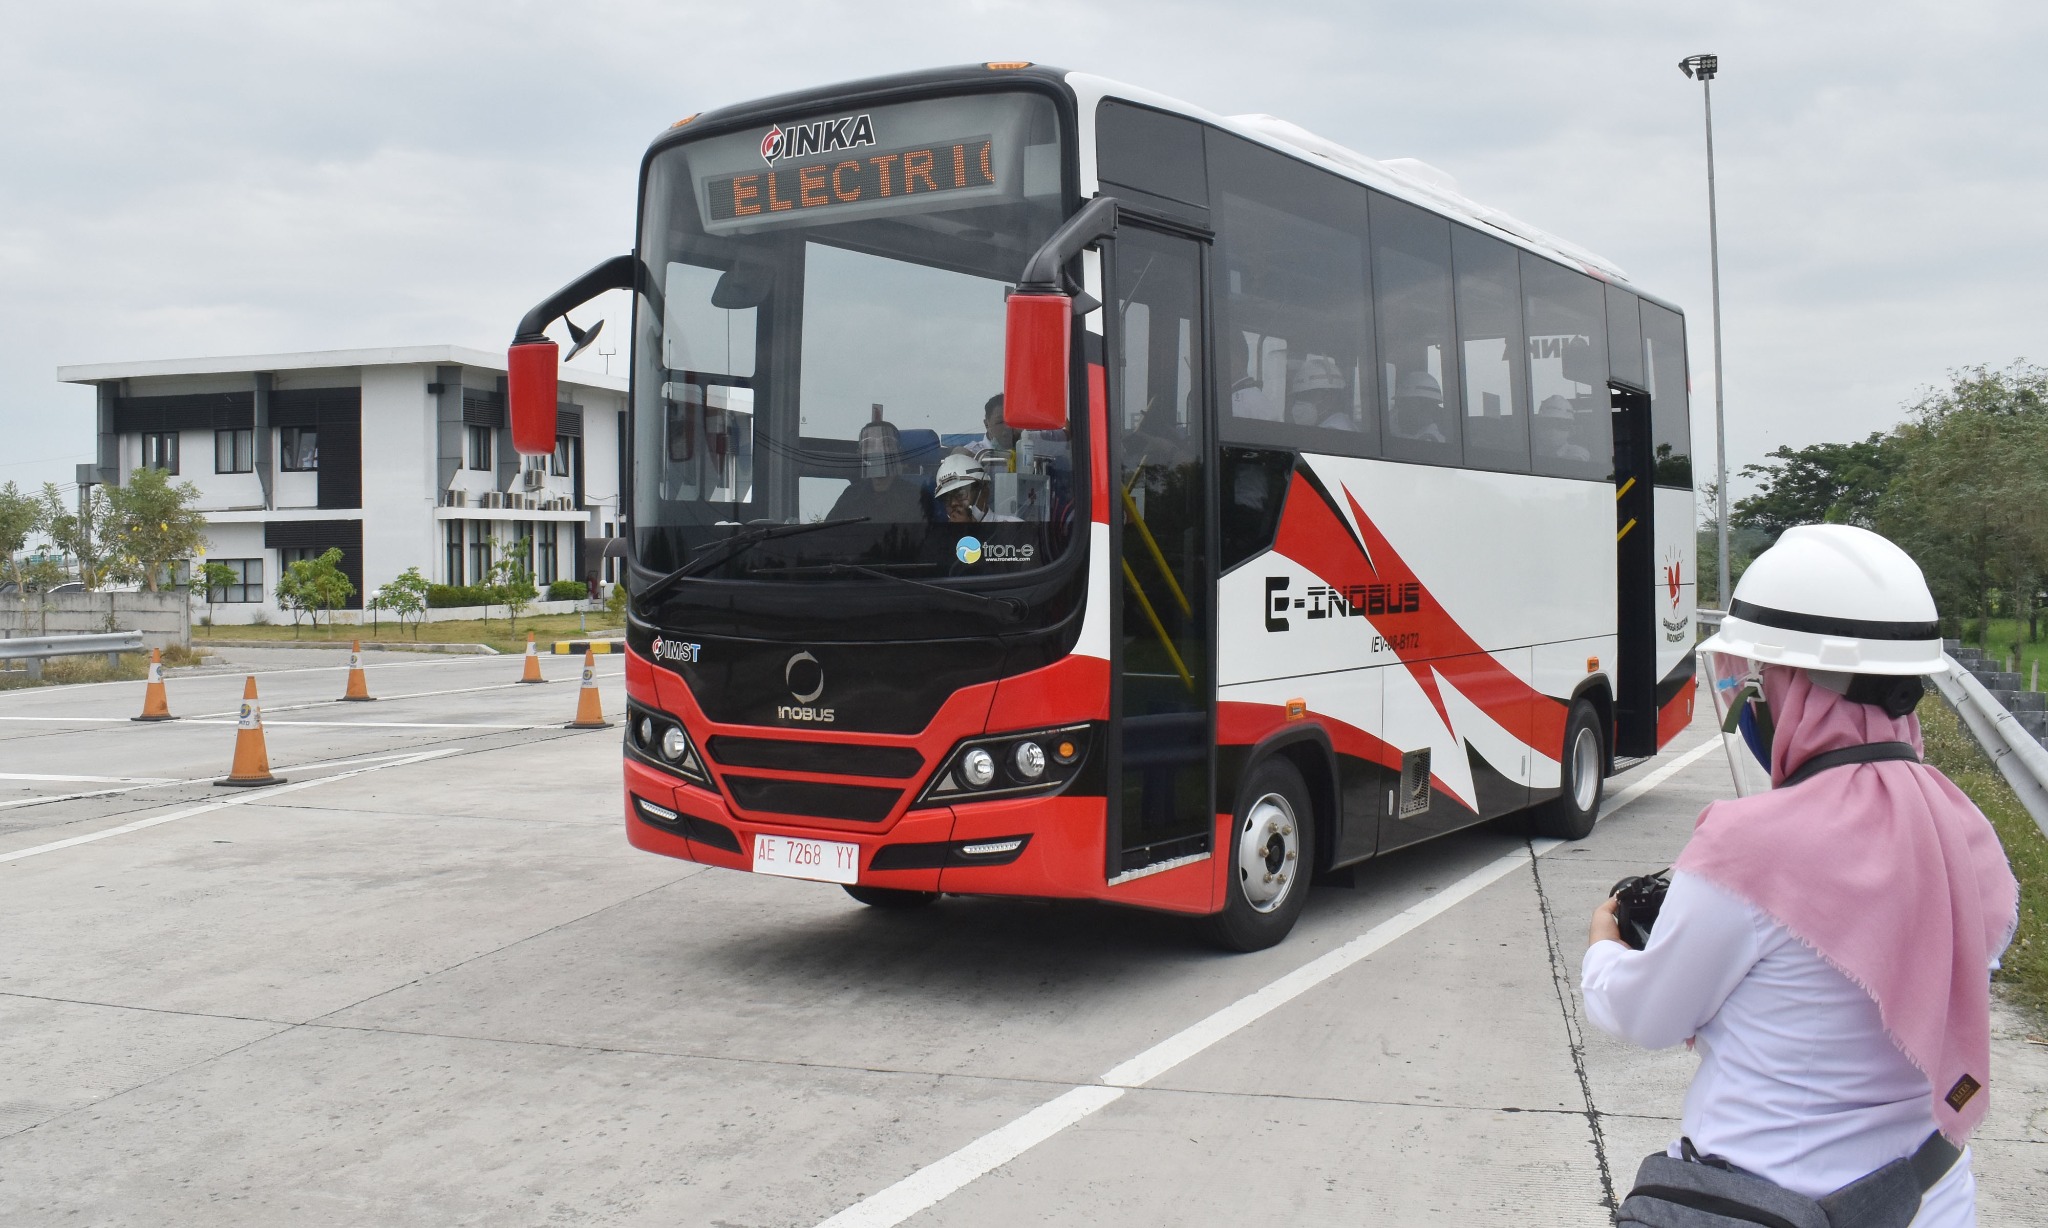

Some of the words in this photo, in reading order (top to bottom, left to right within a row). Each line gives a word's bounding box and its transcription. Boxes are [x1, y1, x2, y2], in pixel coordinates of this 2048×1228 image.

[783, 114, 876, 158] INKA
[982, 541, 1034, 557] tron-e
[664, 639, 701, 663] IMST
[778, 705, 835, 722] INOBUS
[759, 838, 775, 861] AE
[787, 841, 821, 865] 7268
[836, 846, 854, 869] YY
